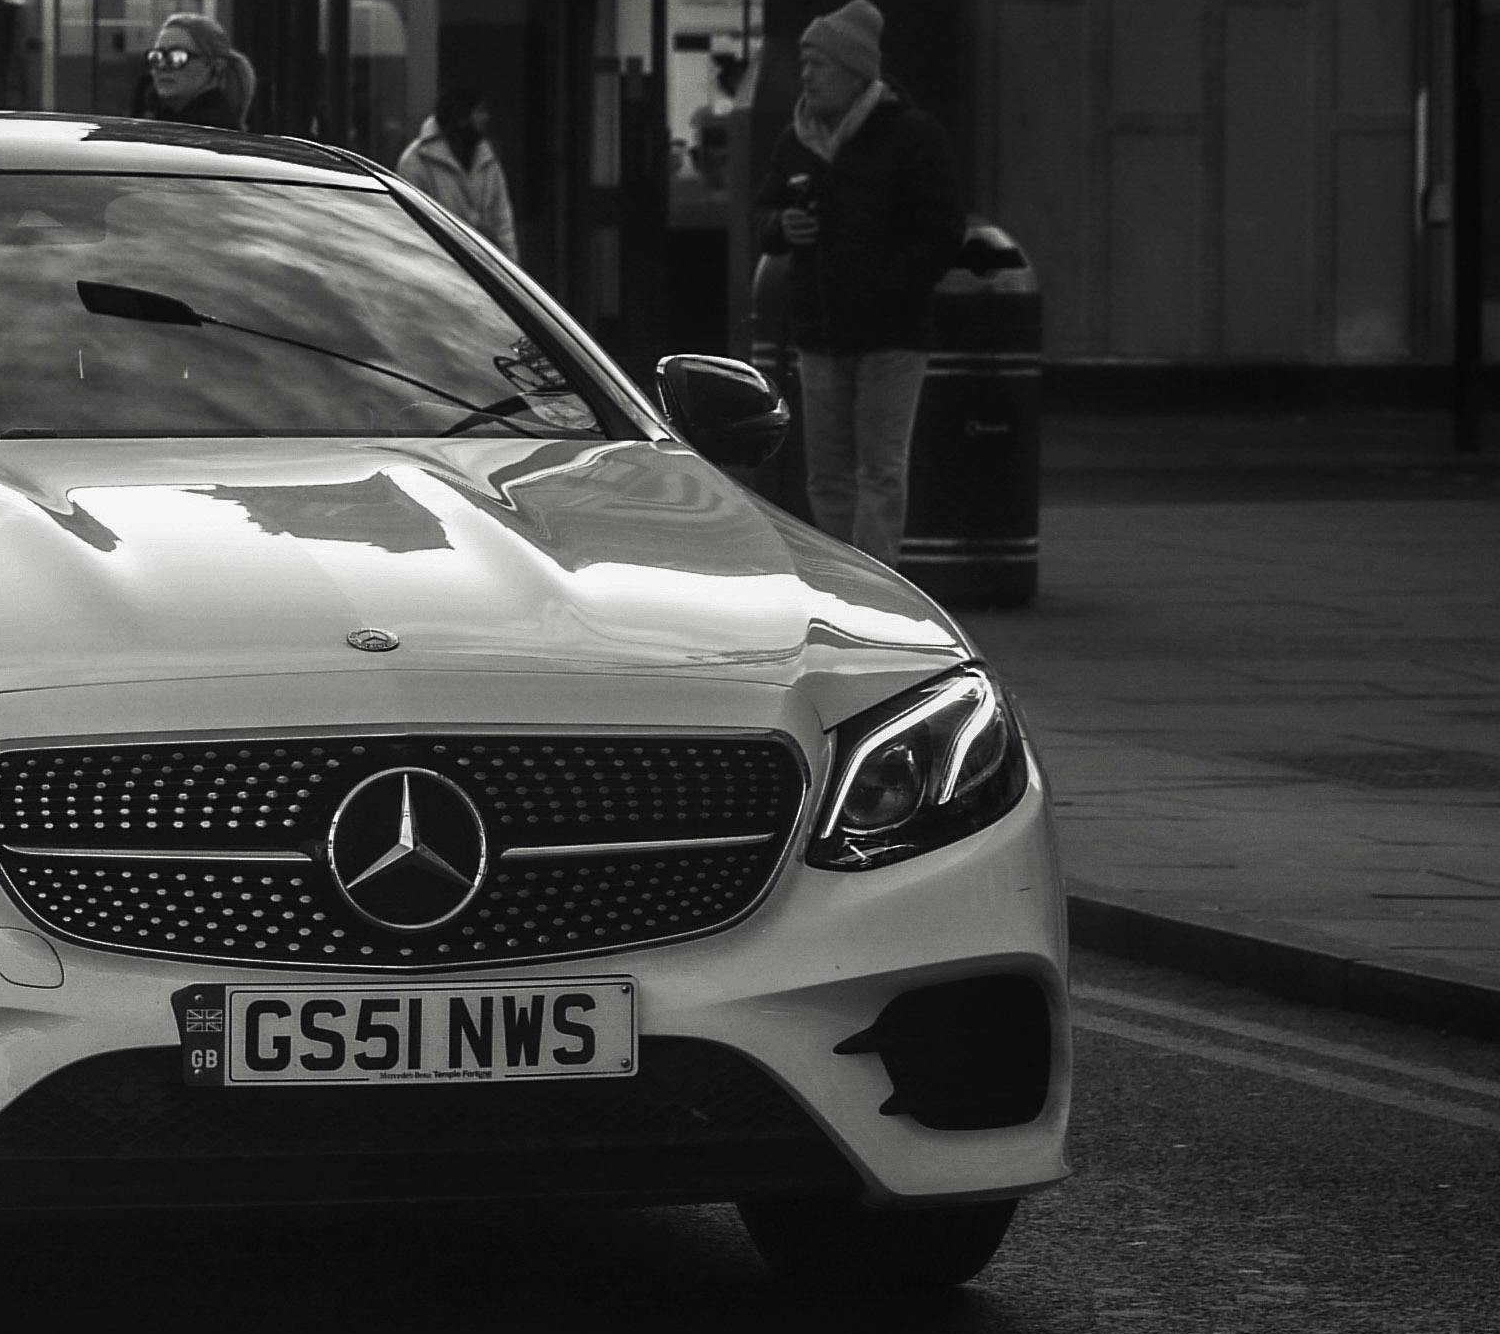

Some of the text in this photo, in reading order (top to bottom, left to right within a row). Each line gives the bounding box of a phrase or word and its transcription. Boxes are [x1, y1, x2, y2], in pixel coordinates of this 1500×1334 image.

[244, 992, 597, 1072] GS51 NWS
[191, 1049, 219, 1068] GB
